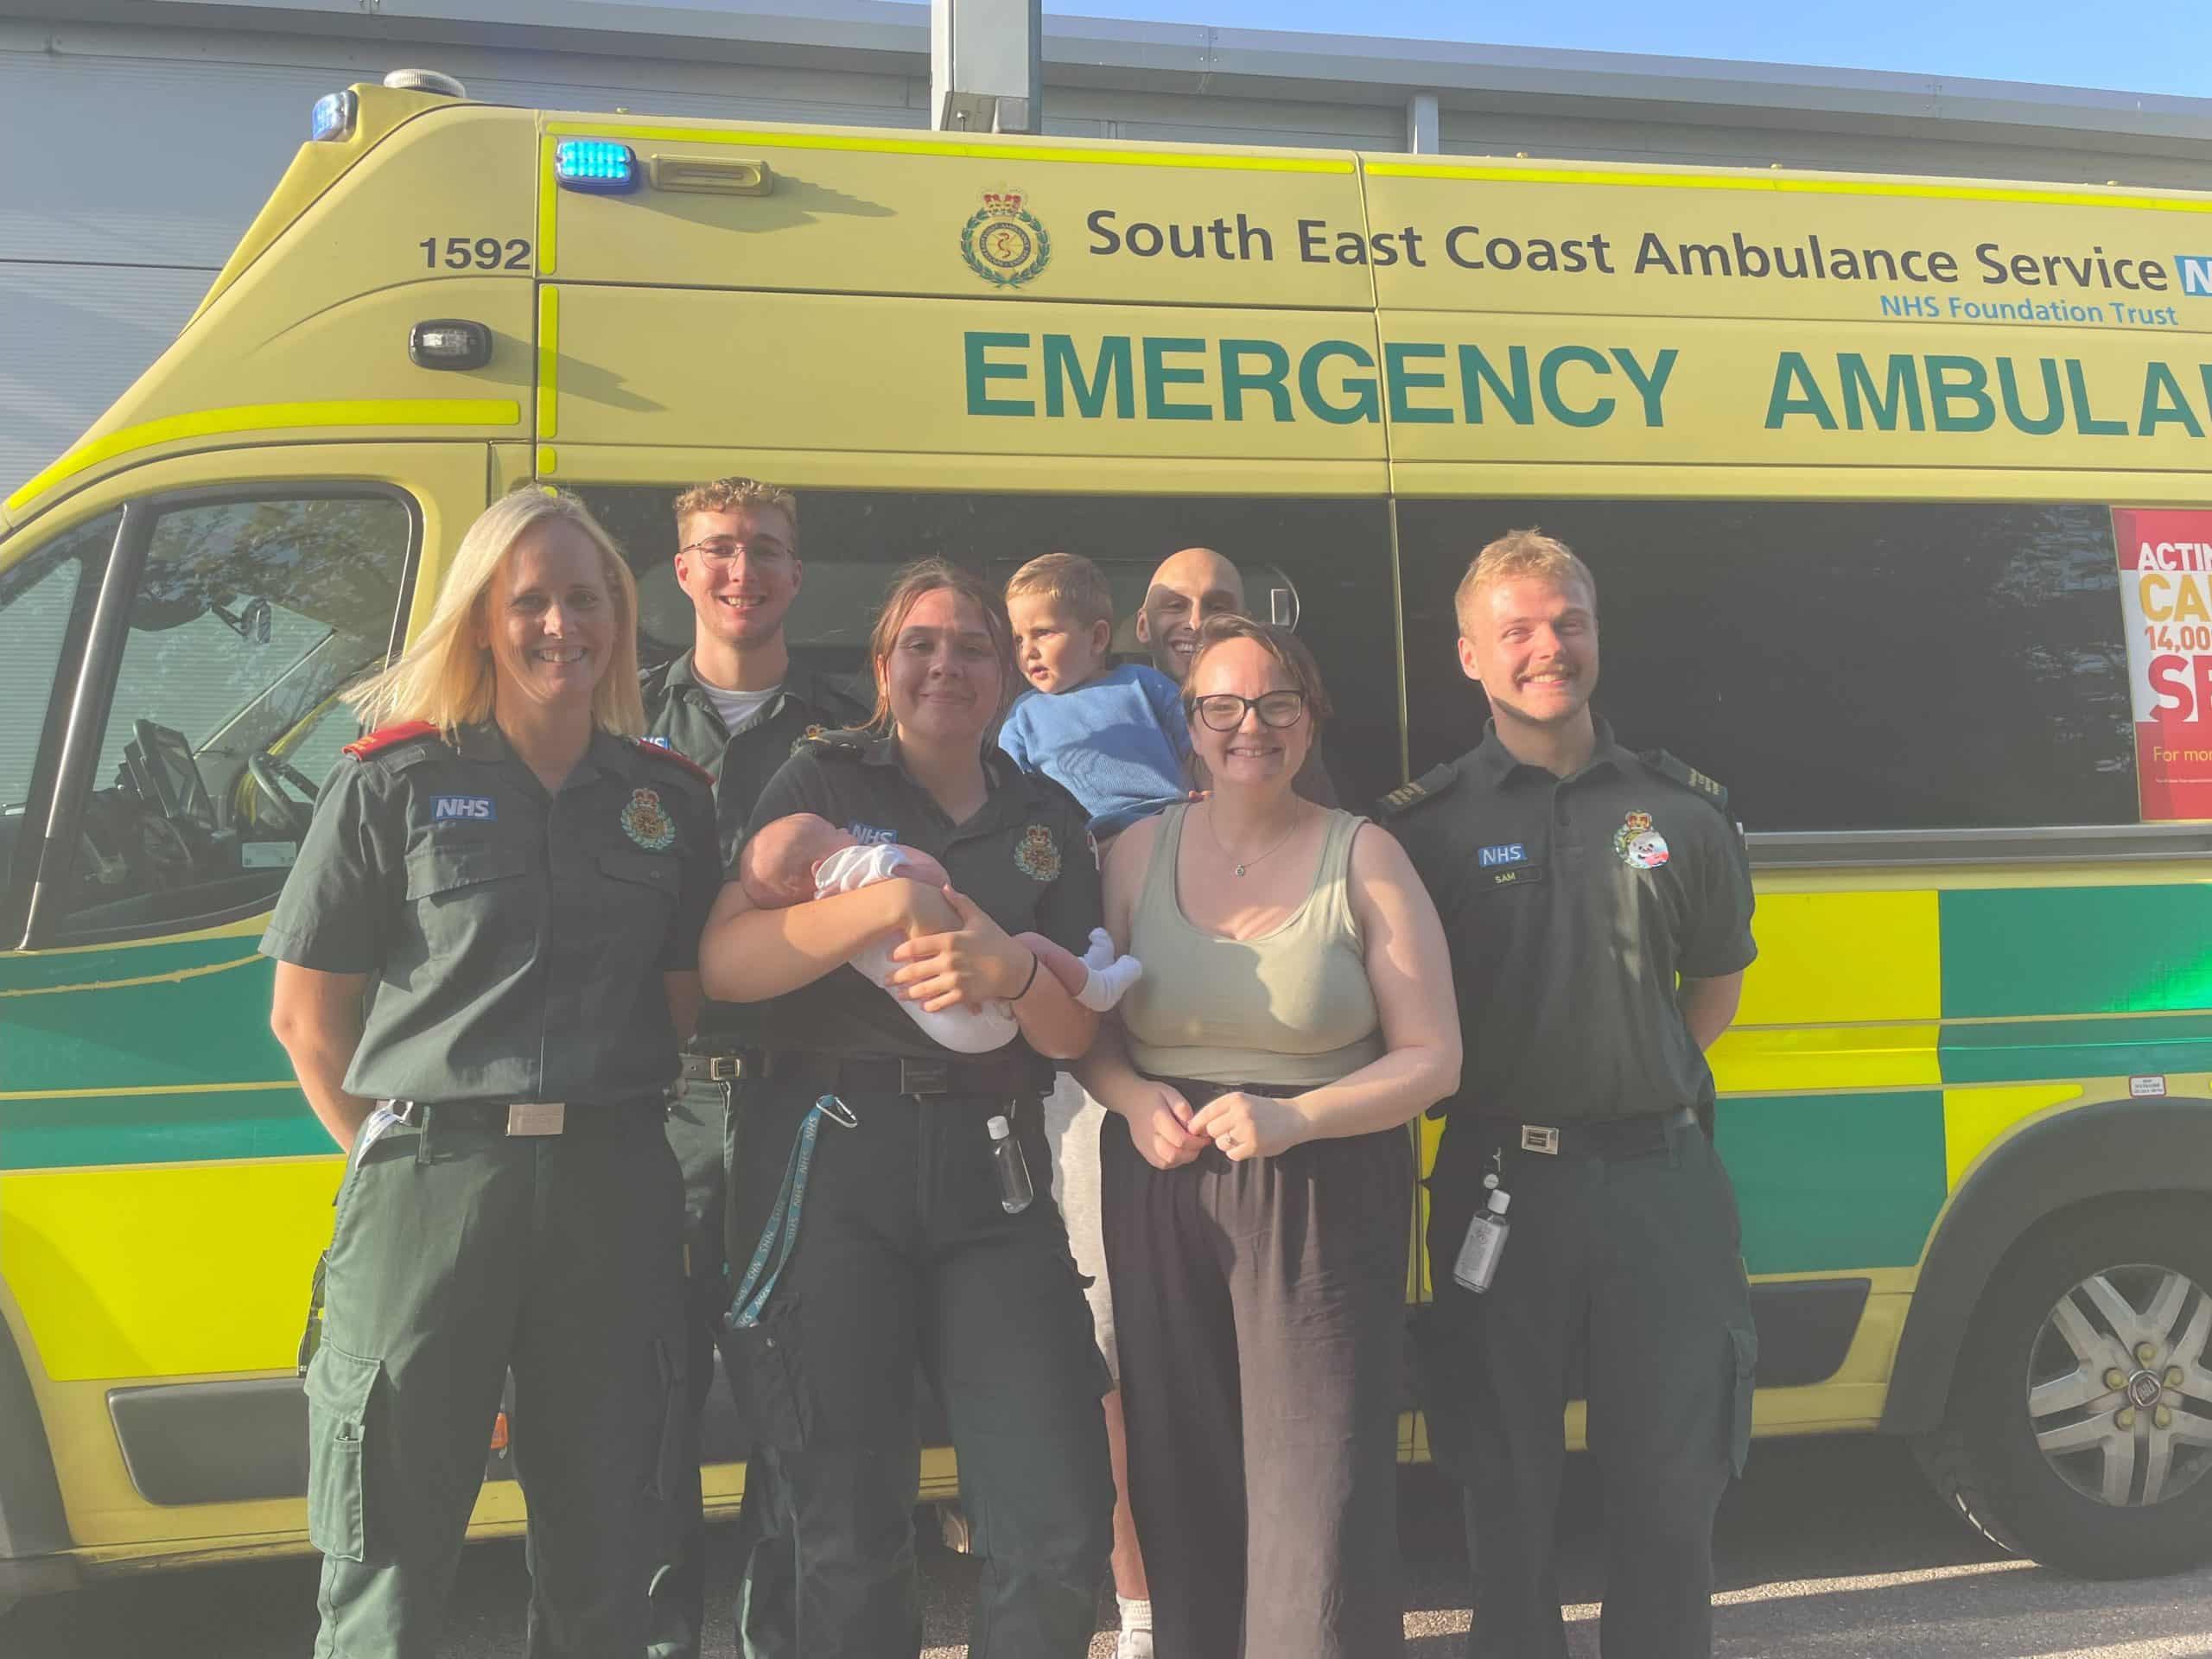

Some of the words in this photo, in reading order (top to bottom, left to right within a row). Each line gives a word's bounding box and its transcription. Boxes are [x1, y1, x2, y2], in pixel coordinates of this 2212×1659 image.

[420, 237, 531, 270] 1592
[1087, 209, 1273, 261] South
[1298, 219, 1426, 267] East
[1445, 225, 1615, 274] Coast
[1635, 232, 1958, 283] Ambulance
[1976, 243, 2167, 291] Service
[1880, 296, 1941, 319] NHS
[1949, 297, 2104, 323] Foundation
[2111, 303, 2177, 326] Trust
[963, 330, 1679, 428] EMERGENCY
[1764, 351, 2212, 438] AMBULA
[2139, 573, 2212, 623] CA
[2153, 746, 2180, 762] For
[435, 798, 489, 817] NHS
[852, 823, 893, 845] NHS
[1483, 845, 1522, 865] NHS
[1495, 872, 1516, 884] SAM
